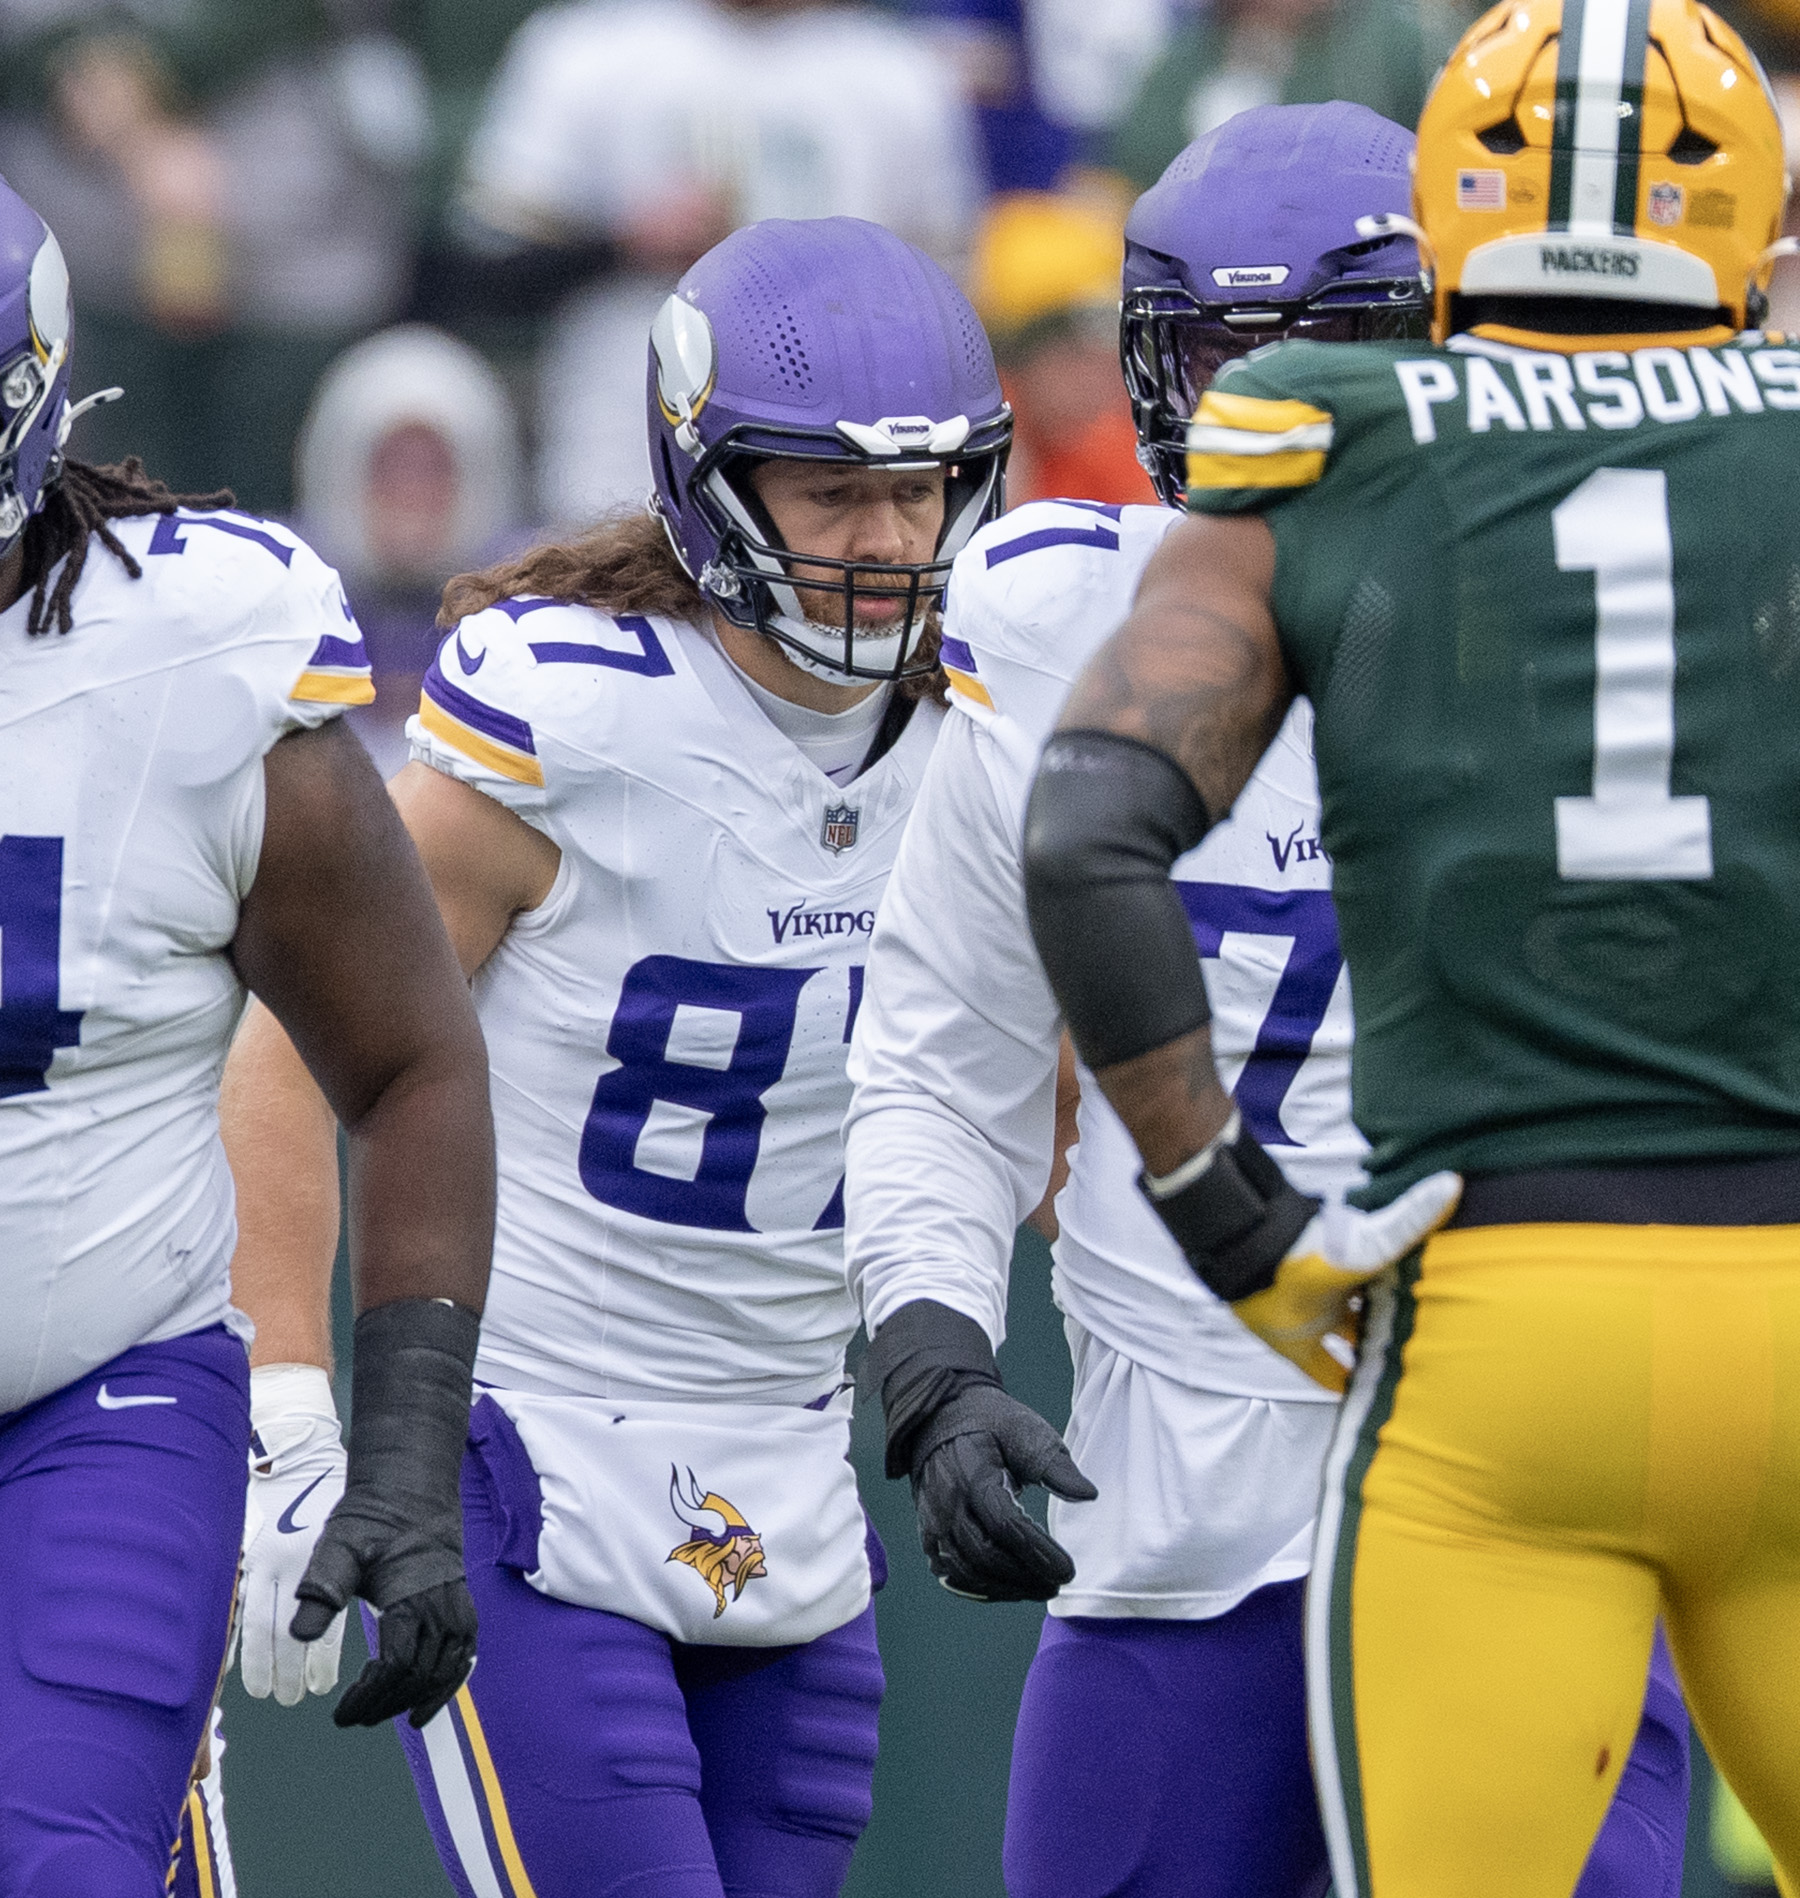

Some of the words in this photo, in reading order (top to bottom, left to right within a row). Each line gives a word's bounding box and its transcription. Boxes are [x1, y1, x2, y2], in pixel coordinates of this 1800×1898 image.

[1540, 245, 1641, 277] PACKERS
[1394, 347, 1800, 445] PARSONS
[1552, 468, 1714, 880] 1
[767, 898, 876, 944] VIKING
